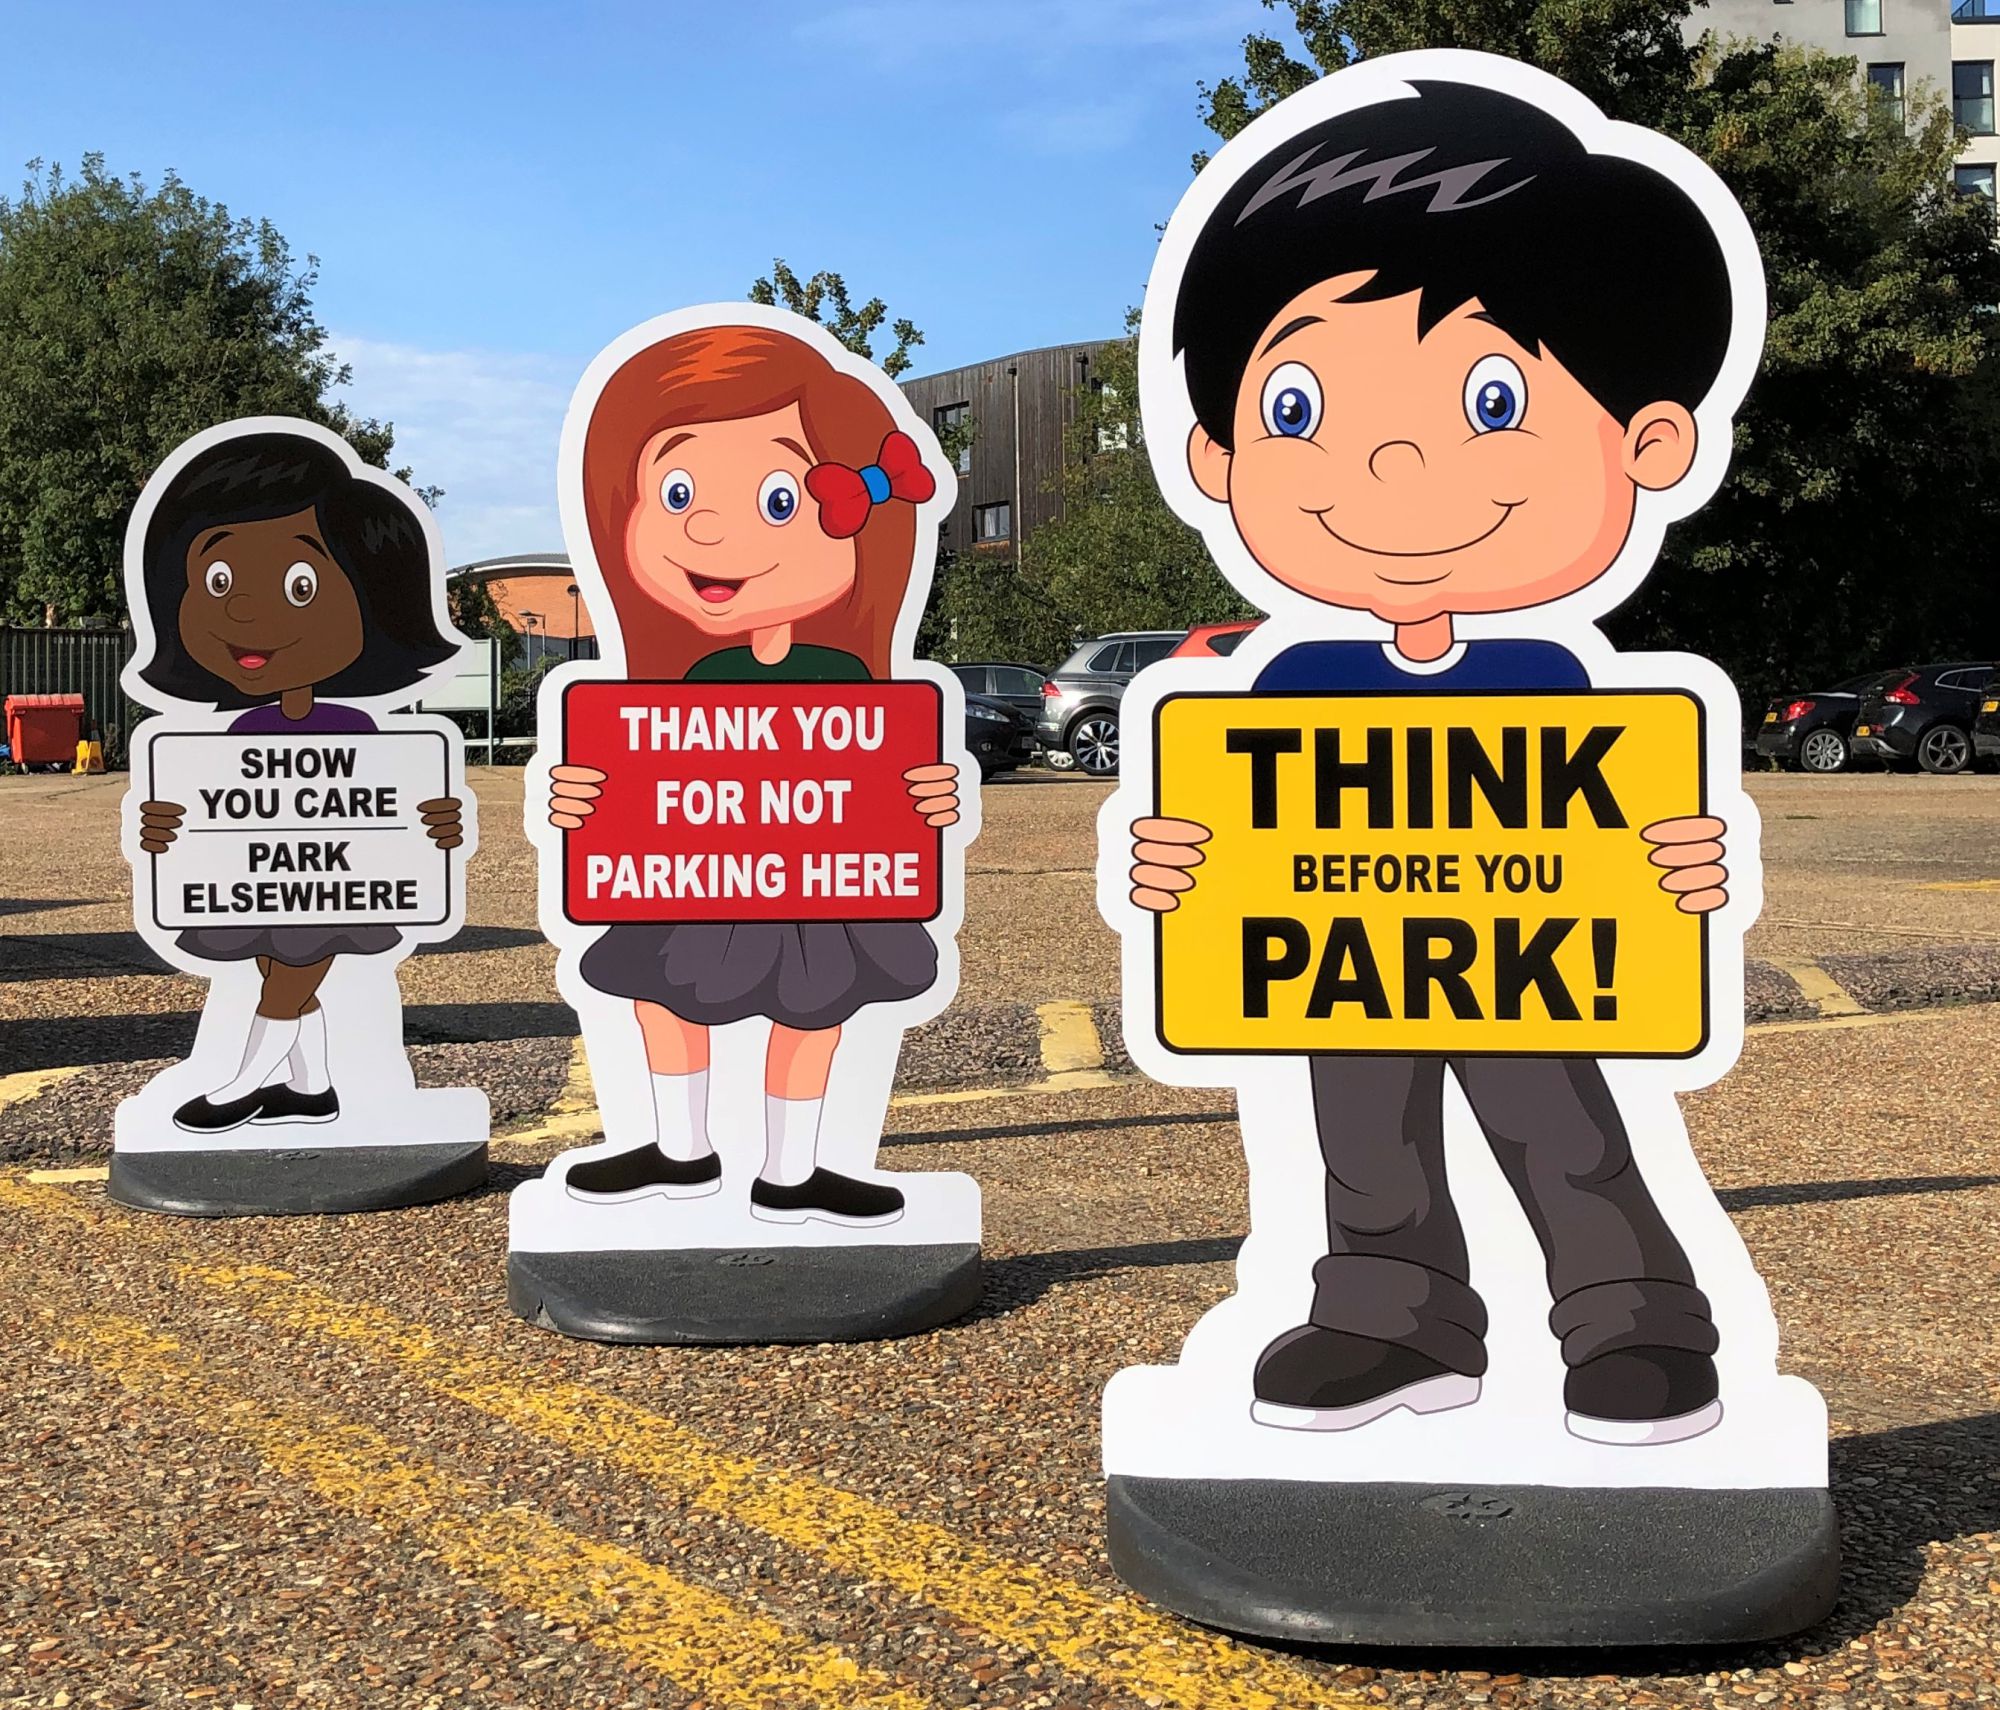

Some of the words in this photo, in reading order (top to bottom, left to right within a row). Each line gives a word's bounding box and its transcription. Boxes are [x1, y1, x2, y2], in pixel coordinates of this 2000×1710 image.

[620, 706, 780, 751] THANK
[793, 706, 885, 751] YOU
[240, 747, 357, 780] SHOW
[1226, 726, 1629, 829] THINK
[198, 788, 280, 820] YOU
[294, 787, 398, 819] CARE
[656, 779, 746, 825] FOR
[760, 779, 853, 825] NOT
[248, 841, 352, 873] PARK
[587, 853, 786, 899] PARKING
[802, 852, 920, 897] HERE
[1293, 854, 1460, 893] BEFORE
[1475, 854, 1562, 894] YOU
[183, 879, 418, 914] ELSEWHERE
[1242, 917, 1617, 1021] PARK!
